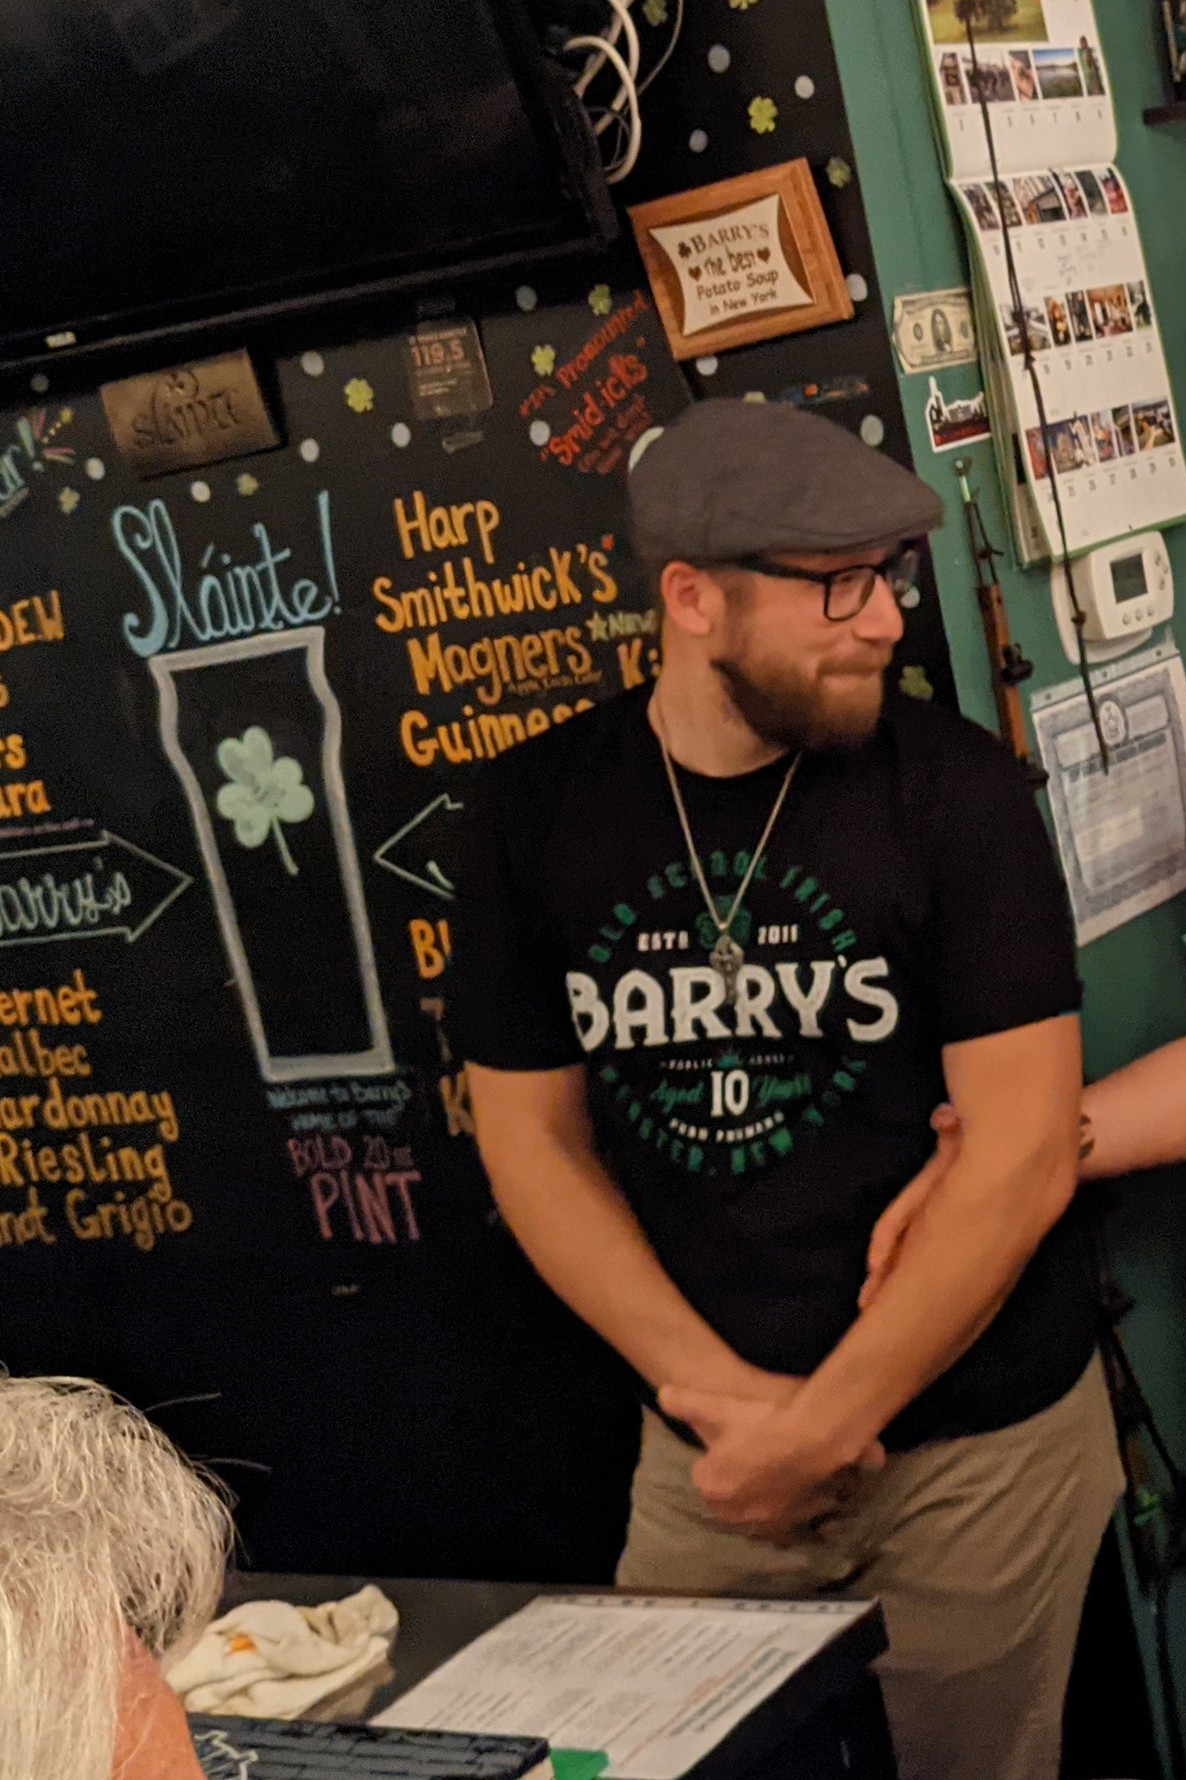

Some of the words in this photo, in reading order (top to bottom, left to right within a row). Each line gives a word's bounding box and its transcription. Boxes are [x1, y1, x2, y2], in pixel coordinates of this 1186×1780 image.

[690, 222, 770, 252] BARRY'S
[703, 254, 727, 277] The
[725, 246, 757, 274] best
[697, 277, 742, 300] Potato
[747, 269, 779, 288] Soup
[709, 301, 721, 315] in
[722, 297, 749, 312] New
[752, 288, 778, 304] York
[393, 489, 501, 565] Harp
[112, 489, 343, 658] Sláinte!
[372, 542, 619, 634] Smithwick's
[406, 625, 593, 706] Magners
[757, 923, 799, 945] 2011
[565, 954, 900, 1052] BARRY'S
[710, 1068, 750, 1118] 10
[0, 1133, 173, 1201] Riesling
[65, 1188, 194, 1252] Grigio
[310, 1171, 423, 1245] PINT
